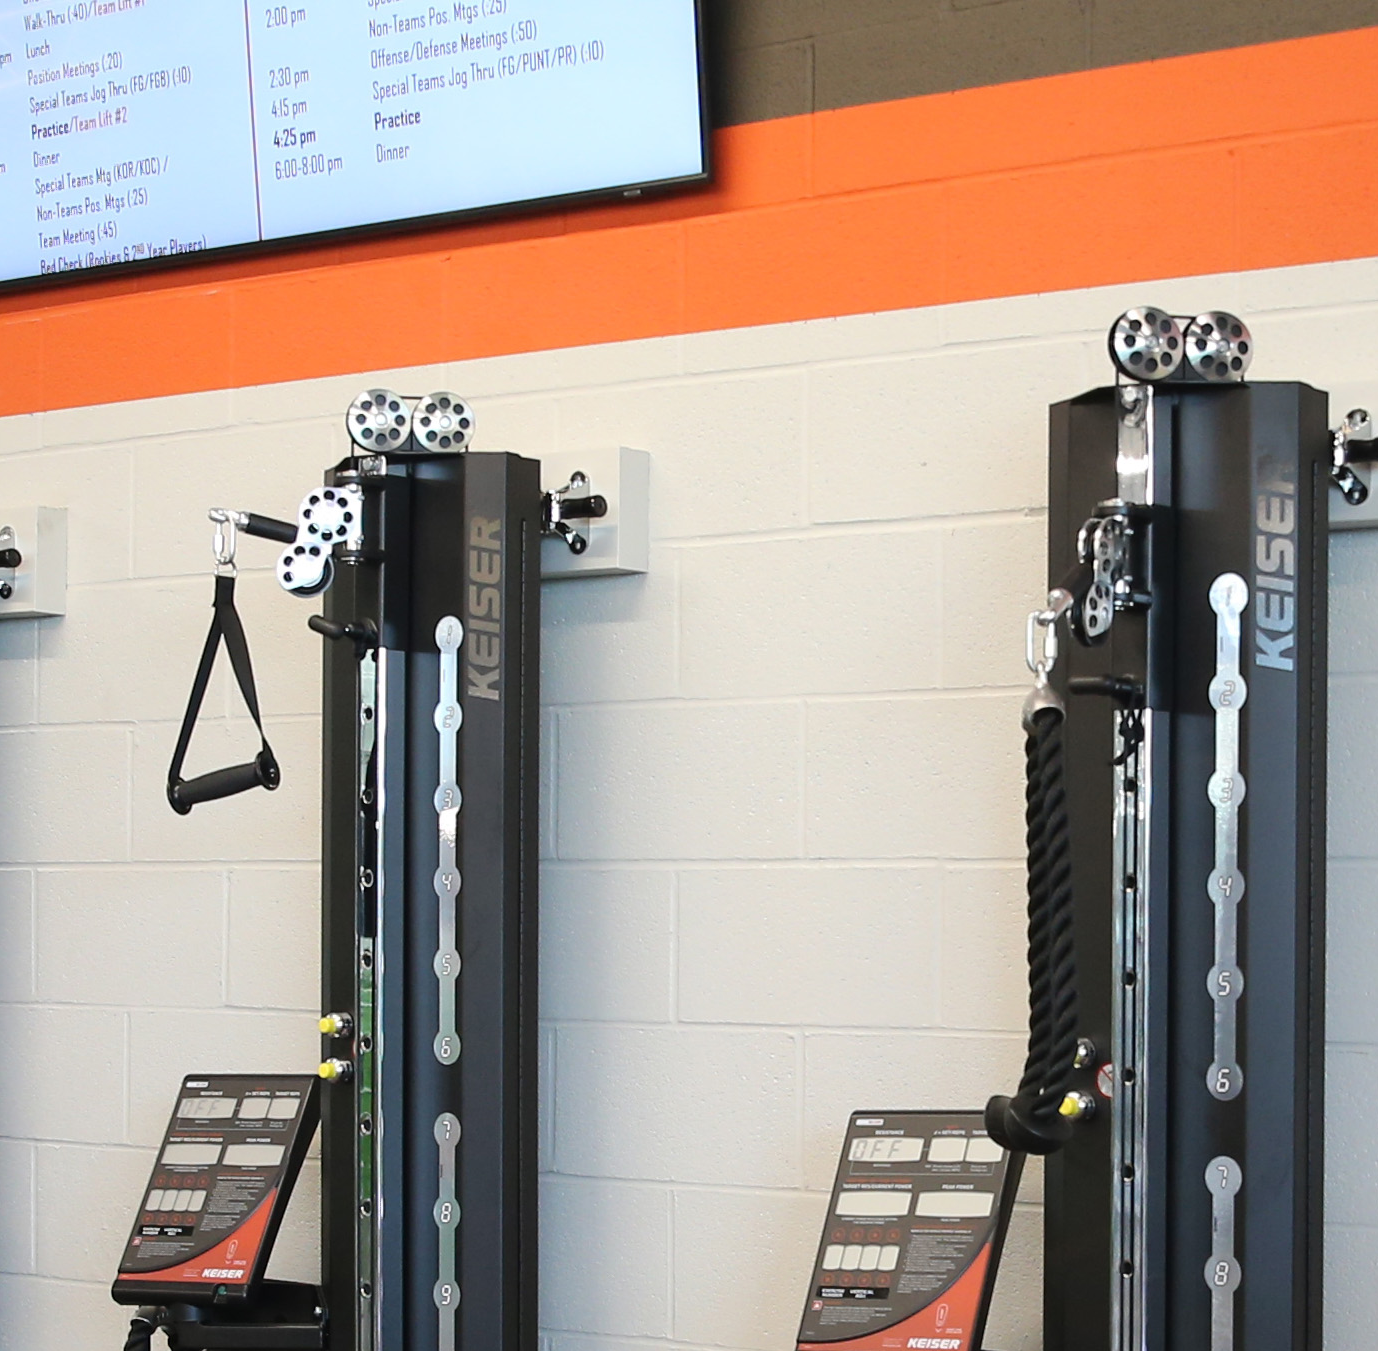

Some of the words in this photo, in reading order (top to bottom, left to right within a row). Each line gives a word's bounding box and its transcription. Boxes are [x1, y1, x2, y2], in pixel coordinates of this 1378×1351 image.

[24, 10, 66, 32] Walk-Thru
[67, 1, 116, 25] (:40)/Team
[266, 8, 289, 29] 2:00
[290, 8, 306, 25] pm
[369, 12, 426, 38] Non-Teams
[429, 6, 450, 26] Pos.
[453, 2, 479, 24] Mtgs
[25, 39, 50, 60] Lunch
[371, 39, 458, 70] Offense/Defense
[461, 28, 508, 51] Meetings
[511, 19, 537, 43] (:50)
[0, 51, 12, 69] pm
[27, 64, 61, 87] Position
[62, 59, 100, 80] Meetings
[102, 51, 123, 72] (:20)
[373, 74, 409, 103] Special
[412, 71, 445, 93] Teams
[448, 67, 468, 89] Jog
[470, 61, 495, 83] Thru
[498, 44, 577, 79] (FG/PUNT/PR)
[580, 40, 604, 64] (:10)
[30, 92, 59, 117] Special
[61, 87, 89, 107] Teams
[90, 85, 106, 104] Jog
[108, 79, 128, 98] Thru
[172, 65, 192, 87] (:10)
[269, 67, 292, 89] 2:30
[295, 69, 309, 87] pm
[271, 98, 290, 119] 4:15
[292, 99, 307, 117] pm
[374, 110, 421, 131] Practice
[31, 116, 97, 140] Practice/Team
[98, 109, 113, 128] Lift
[114, 106, 128, 125] #2
[273, 128, 297, 149] 4:25
[300, 128, 316, 148] pm
[33, 151, 60, 168] Dinner
[376, 143, 410, 163] Dinner
[275, 154, 324, 181] 6:00-8:00
[327, 155, 343, 174] pm
[35, 174, 65, 198] Special
[66, 170, 94, 191] Teams
[96, 167, 111, 187] Mtg
[37, 197, 83, 222] Non-Teams
[85, 196, 103, 214] Pos.
[105, 192, 125, 213] Mtgs
[127, 187, 148, 208] (:25)
[39, 232, 61, 249] Team
[63, 226, 95, 247] Meeting
[97, 220, 118, 241] (:45)
[58, 252, 83, 271] Check
[147, 239, 167, 258] Year
[468, 515, 502, 701] KEISER
[1220, 679, 1236, 706] 2
[1220, 777, 1233, 803] 3
[1218, 876, 1232, 898] 4
[1217, 971, 1231, 996] 5
[1215, 1067, 1230, 1094] 6
[1216, 1165, 1228, 1189] 7
[202, 1268, 245, 1279] KEISER
[1214, 1261, 1229, 1287] 8
[907, 1337, 962, 1350] KEISER
